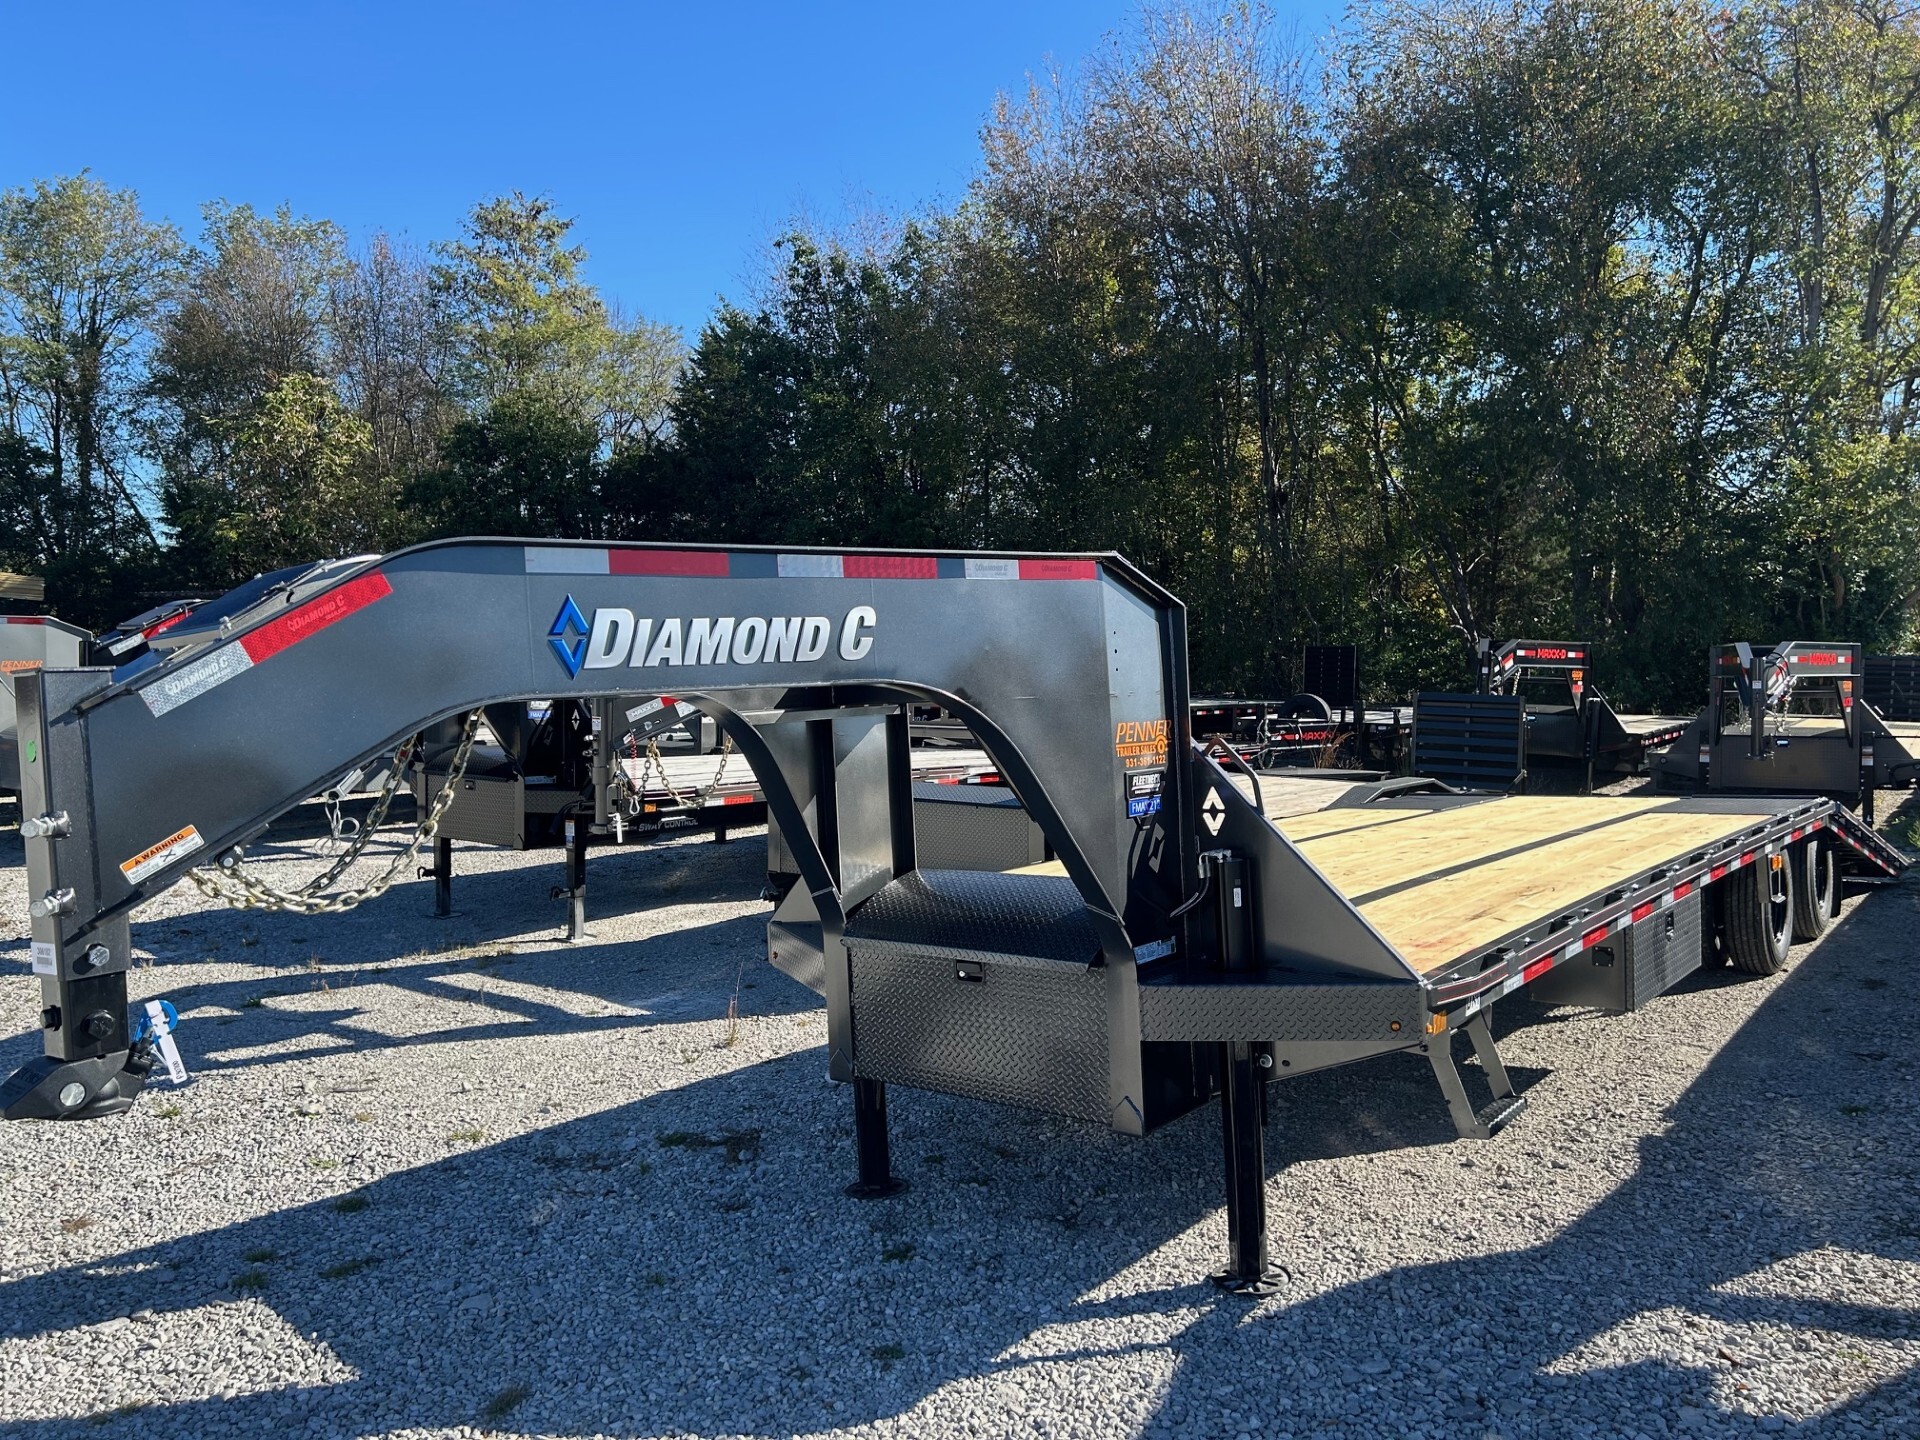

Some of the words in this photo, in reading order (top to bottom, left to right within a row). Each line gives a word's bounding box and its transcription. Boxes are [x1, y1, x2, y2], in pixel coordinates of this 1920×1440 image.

[293, 601, 336, 629] DIAMOND
[336, 594, 345, 607] C
[584, 608, 830, 669] DIAMOND
[840, 605, 876, 661] C
[171, 662, 219, 693] DIAMOND
[219, 656, 228, 668] C
[1116, 720, 1172, 743] PENNER
[1116, 745, 1140, 757] TRAILER
[1141, 745, 1157, 755] SALES
[639, 820, 663, 832] SWAY
[141, 833, 185, 860] WARNING
